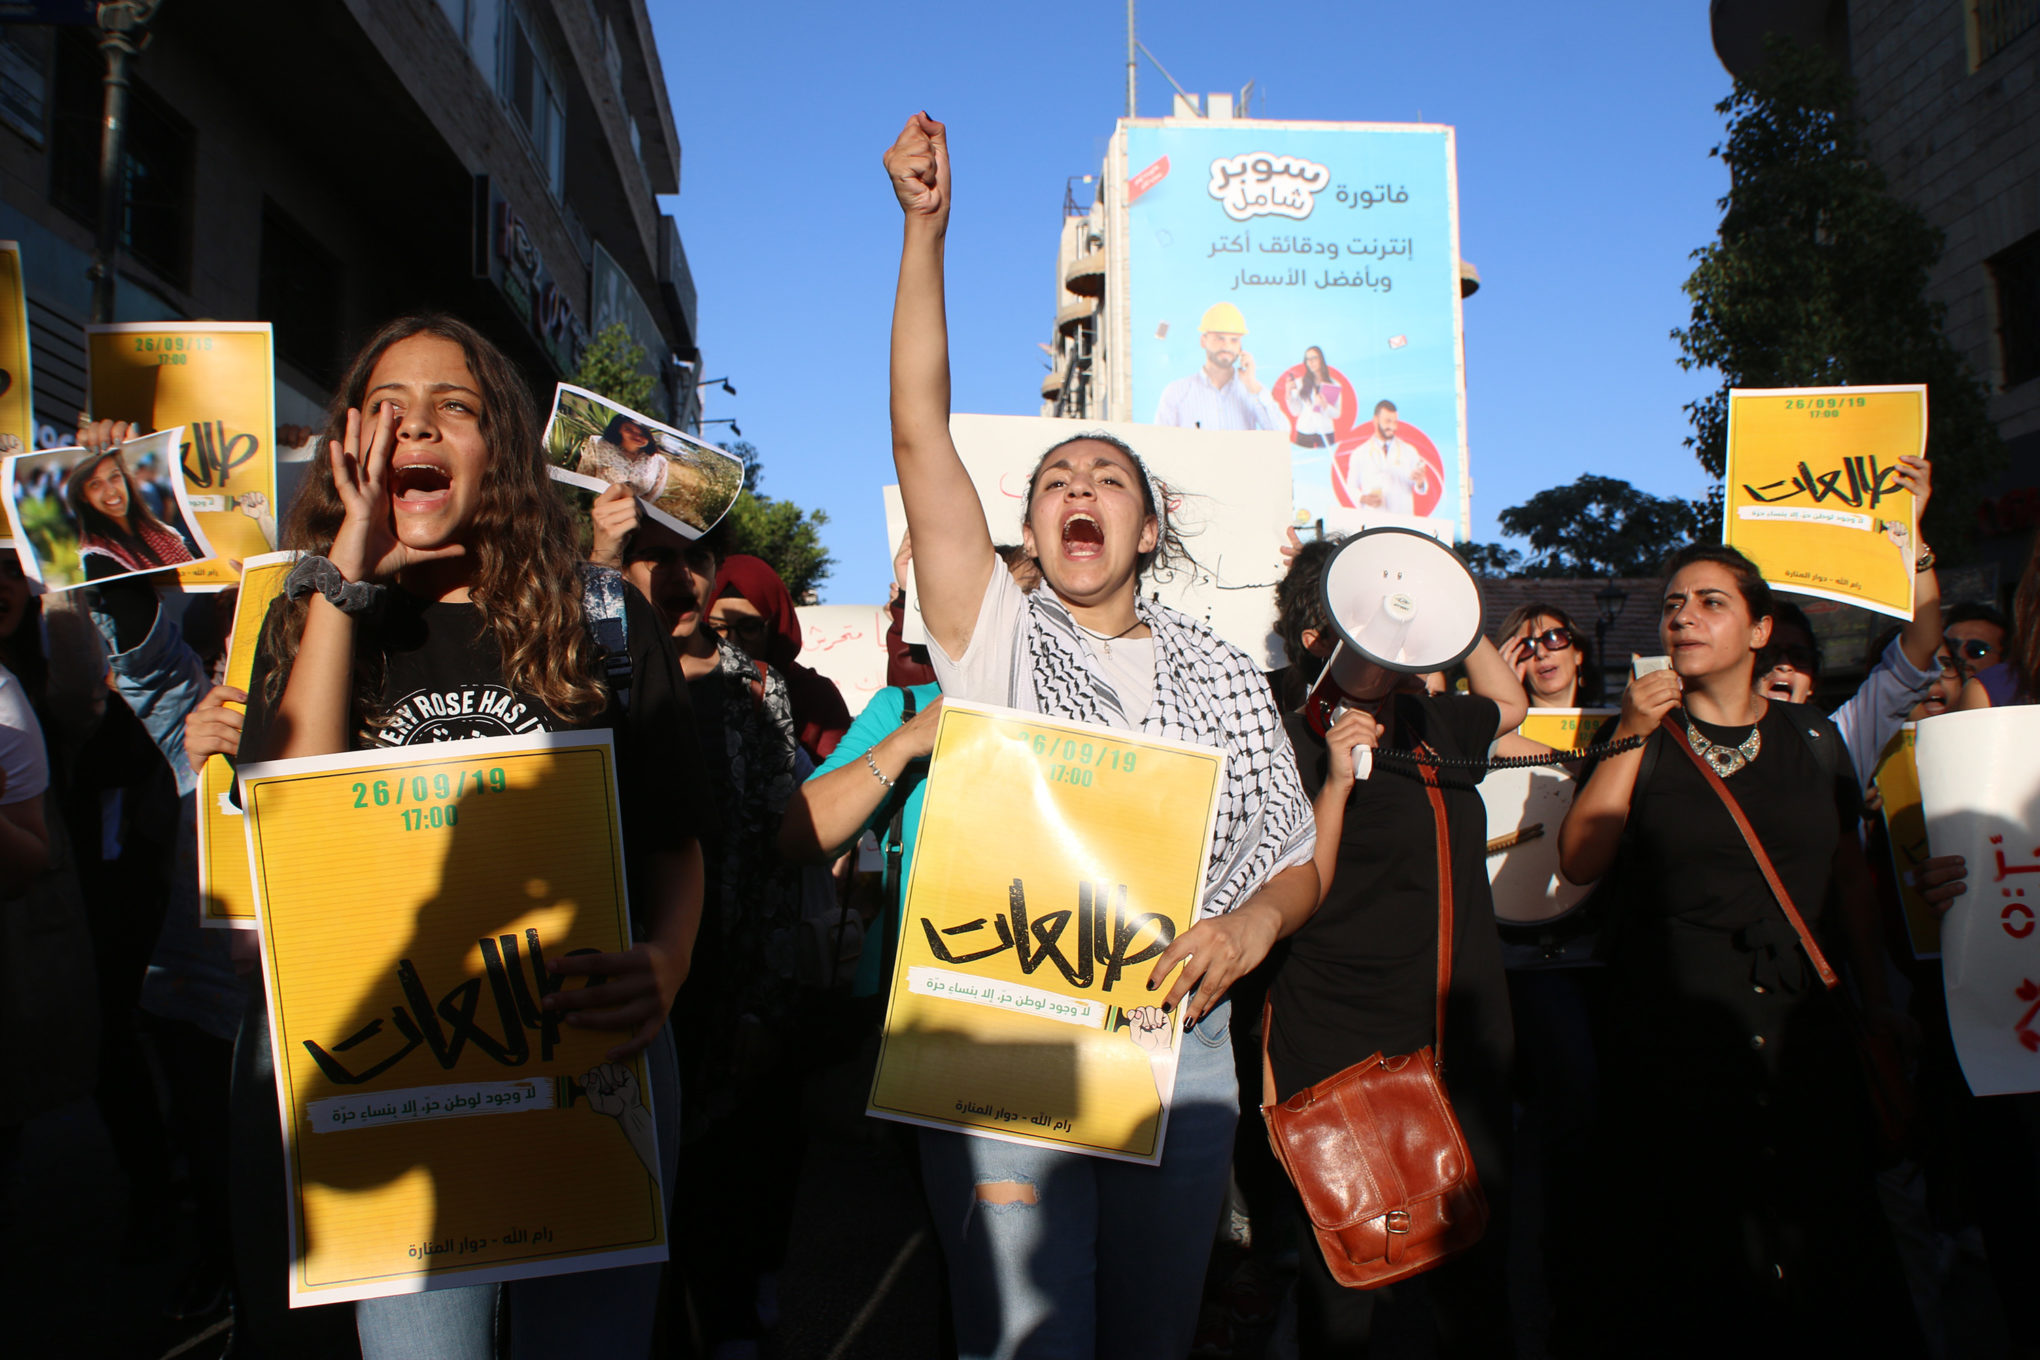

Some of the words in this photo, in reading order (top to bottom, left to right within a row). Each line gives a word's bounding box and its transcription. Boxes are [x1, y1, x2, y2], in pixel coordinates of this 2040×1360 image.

[1217, 158, 1321, 190] سوبر
[1232, 186, 1305, 211] شامل
[1335, 183, 1409, 210] فاتورة
[1206, 230, 1250, 258] أكتر
[1258, 235, 1339, 260] ودقائق
[1346, 237, 1414, 261] إنترنت
[1230, 267, 1306, 291] الأسعار
[1314, 265, 1392, 293] وبأفضل
[134, 336, 213, 352] 26/09/19
[1785, 396, 1867, 410] 26/09/19
[1809, 409, 1840, 419] 17:00
[1742, 454, 1905, 510] طالعات
[376, 704, 419, 748] ERY
[413, 690, 475, 719] ROSE
[478, 690, 527, 724] HAS
[1048, 763, 1094, 788] 17:00
[352, 767, 507, 809] 26/09/19
[400, 804, 459, 832] 17:00
[919, 878, 1176, 992] طالعات
[981, 988, 995, 1004] إلا
[1015, 995, 1046, 1011] لوطن
[1049, 1003, 1078, 1017] وجود
[1081, 1006, 1091, 1017] لا
[485, 1090, 522, 1106] وجود
[524, 1085, 537, 1099] لا
[401, 1099, 418, 1117] إلا
[444, 1092, 482, 1112] لوطن
[955, 1100, 993, 1116] المنارة
[994, 1107, 1019, 1122] دوار
[1030, 1112, 1052, 1127] الله
[1053, 1119, 1072, 1133] رام
[502, 1226, 527, 1245] الله
[532, 1226, 553, 1245] رام
[408, 1238, 454, 1259] المنارة
[458, 1236, 488, 1255] دوار
